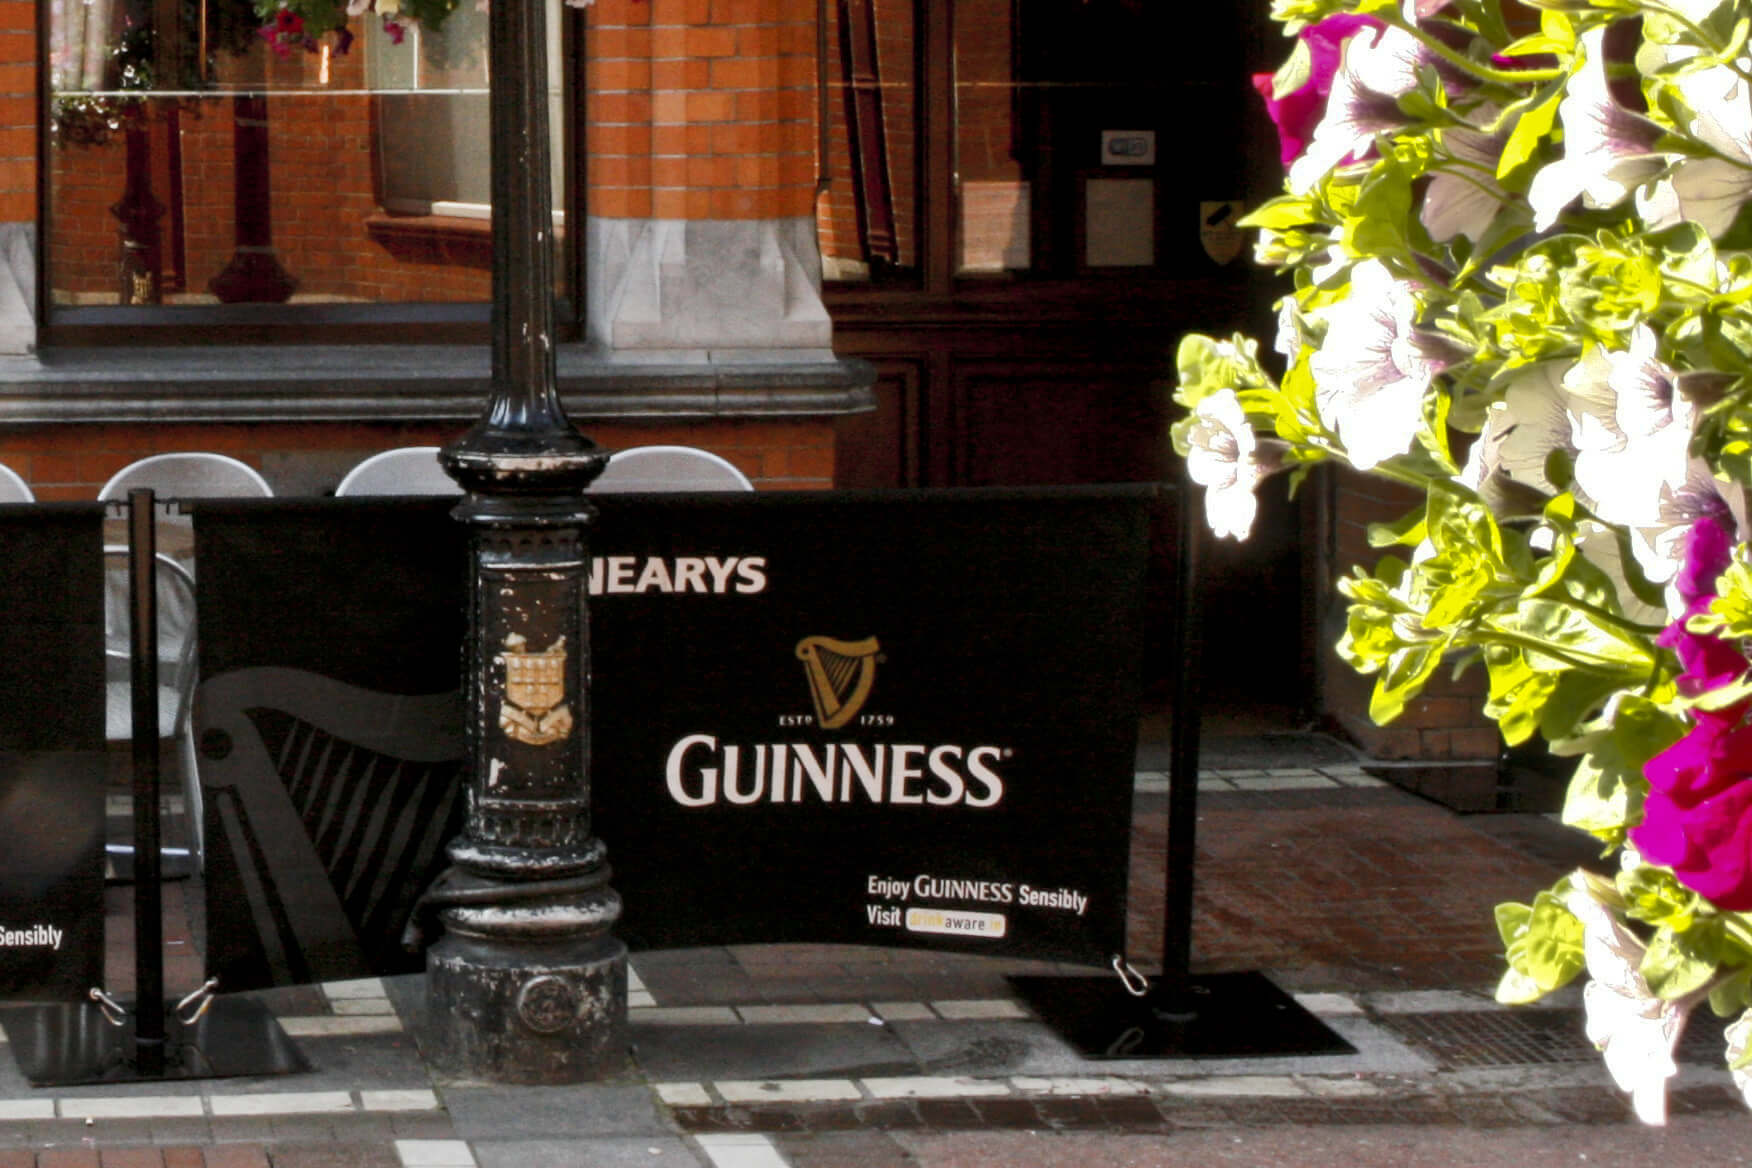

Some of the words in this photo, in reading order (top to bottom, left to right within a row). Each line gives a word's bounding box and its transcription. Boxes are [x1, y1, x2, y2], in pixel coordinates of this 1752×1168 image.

[860, 715, 894, 726] 1759
[665, 734, 1004, 808] GUINNESS
[867, 875, 910, 900] Enjoy
[913, 874, 1013, 903] GUINNESS
[1018, 884, 1088, 915] Sensibly
[866, 904, 902, 927] Visit
